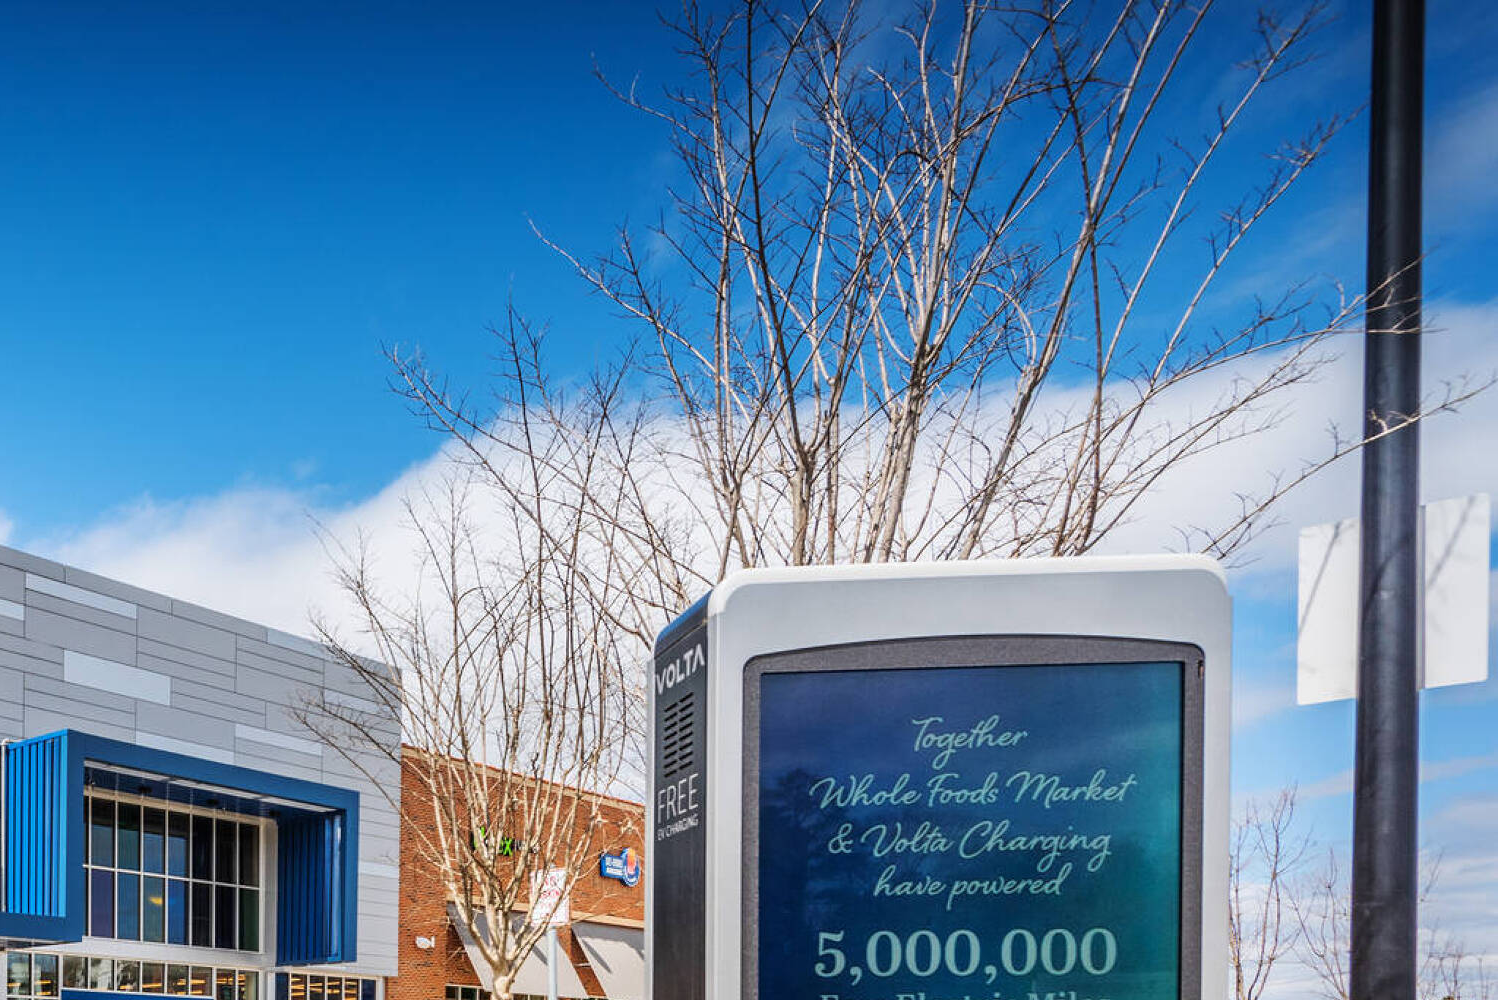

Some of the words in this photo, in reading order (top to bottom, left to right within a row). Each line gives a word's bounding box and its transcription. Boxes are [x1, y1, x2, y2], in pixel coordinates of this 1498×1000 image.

[656, 643, 705, 695] VOLTA
[912, 714, 1028, 770] Together
[658, 773, 699, 824] FREE
[809, 773, 922, 808] Whole
[926, 772, 999, 807] Foods
[1005, 769, 1137, 808] Market
[665, 813, 699, 838] CHARGING
[827, 823, 853, 854] &
[860, 821, 953, 857] Volta
[959, 820, 1112, 873] Charging
[873, 865, 948, 897] have
[946, 863, 1073, 911] powered
[814, 927, 1118, 986] 5,000,000
